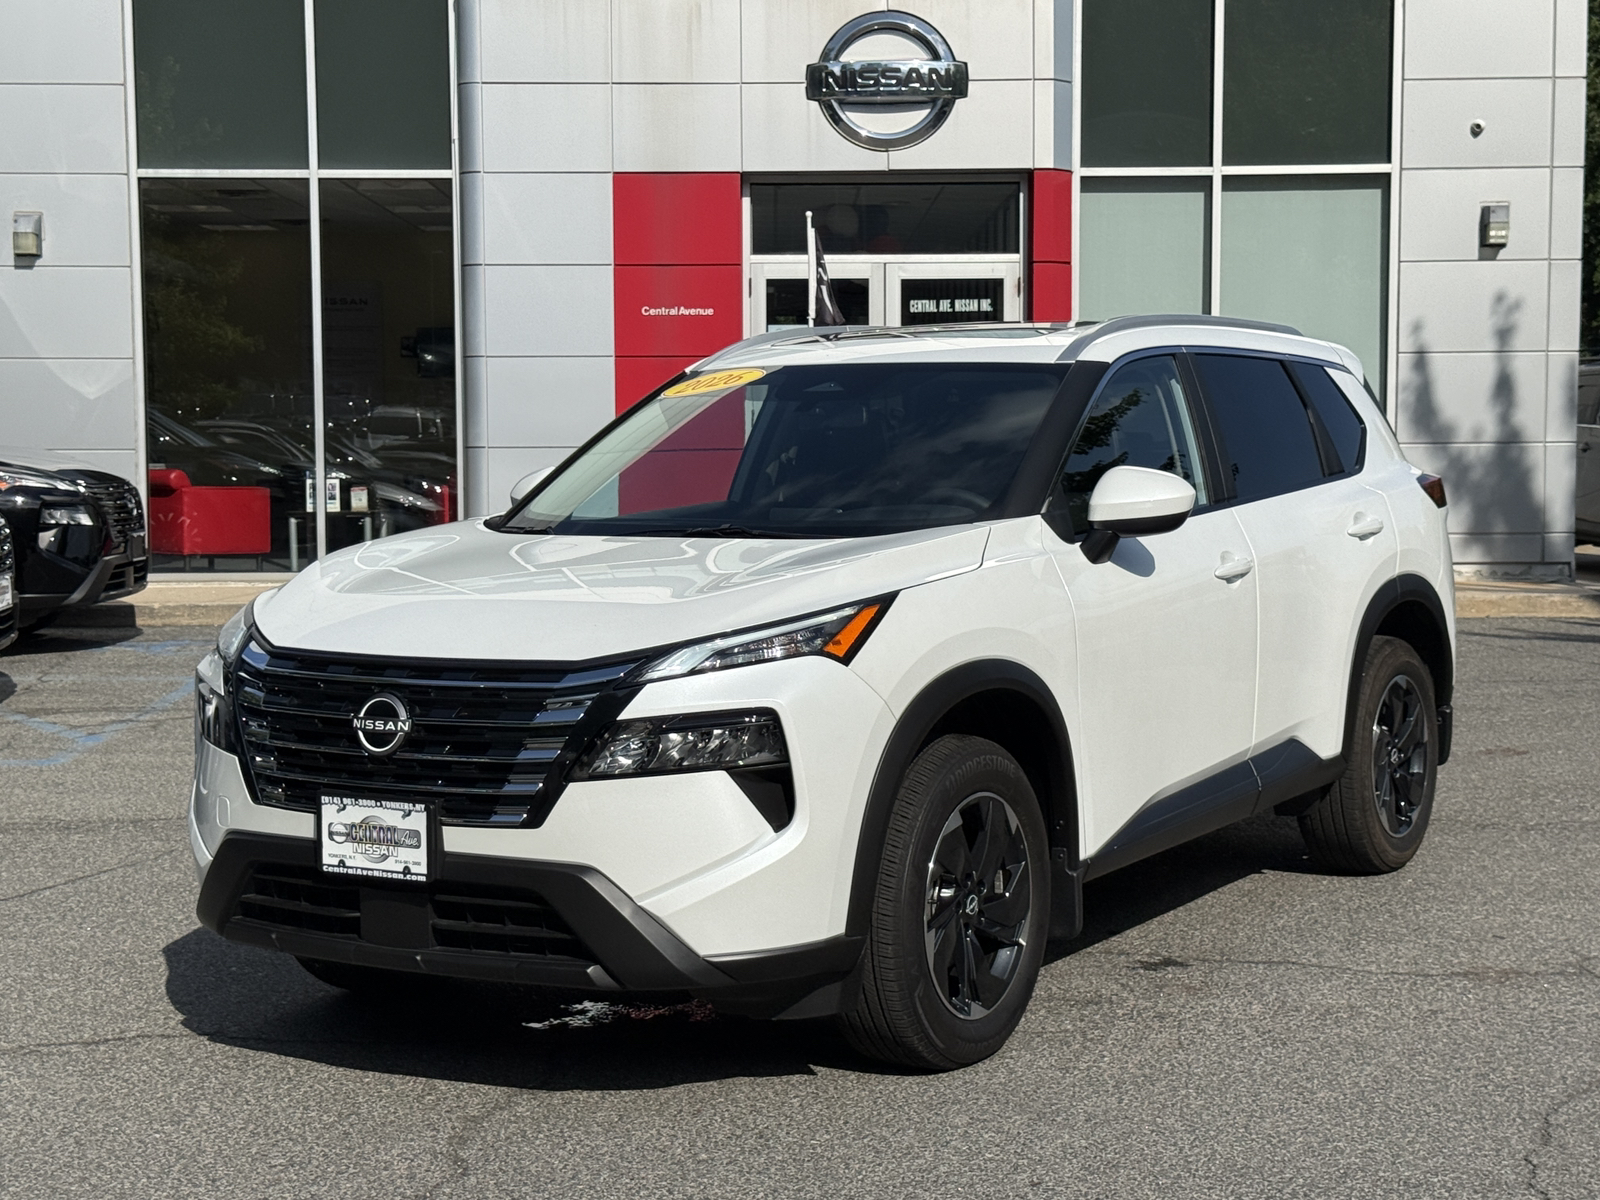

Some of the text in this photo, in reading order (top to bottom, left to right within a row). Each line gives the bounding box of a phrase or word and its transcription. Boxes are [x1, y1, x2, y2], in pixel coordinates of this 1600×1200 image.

[822, 67, 953, 92] NISSAN
[641, 306, 715, 316] Central Avenue
[909, 298, 994, 313] CENTRAL AVE. NISSAN INC.
[672, 371, 754, 395] 2026
[353, 718, 410, 731] NISSAN
[350, 822, 420, 846] CENTRAL Ave.
[353, 843, 399, 858] NISSAN
[322, 865, 427, 882] CentralAveNissan.com
